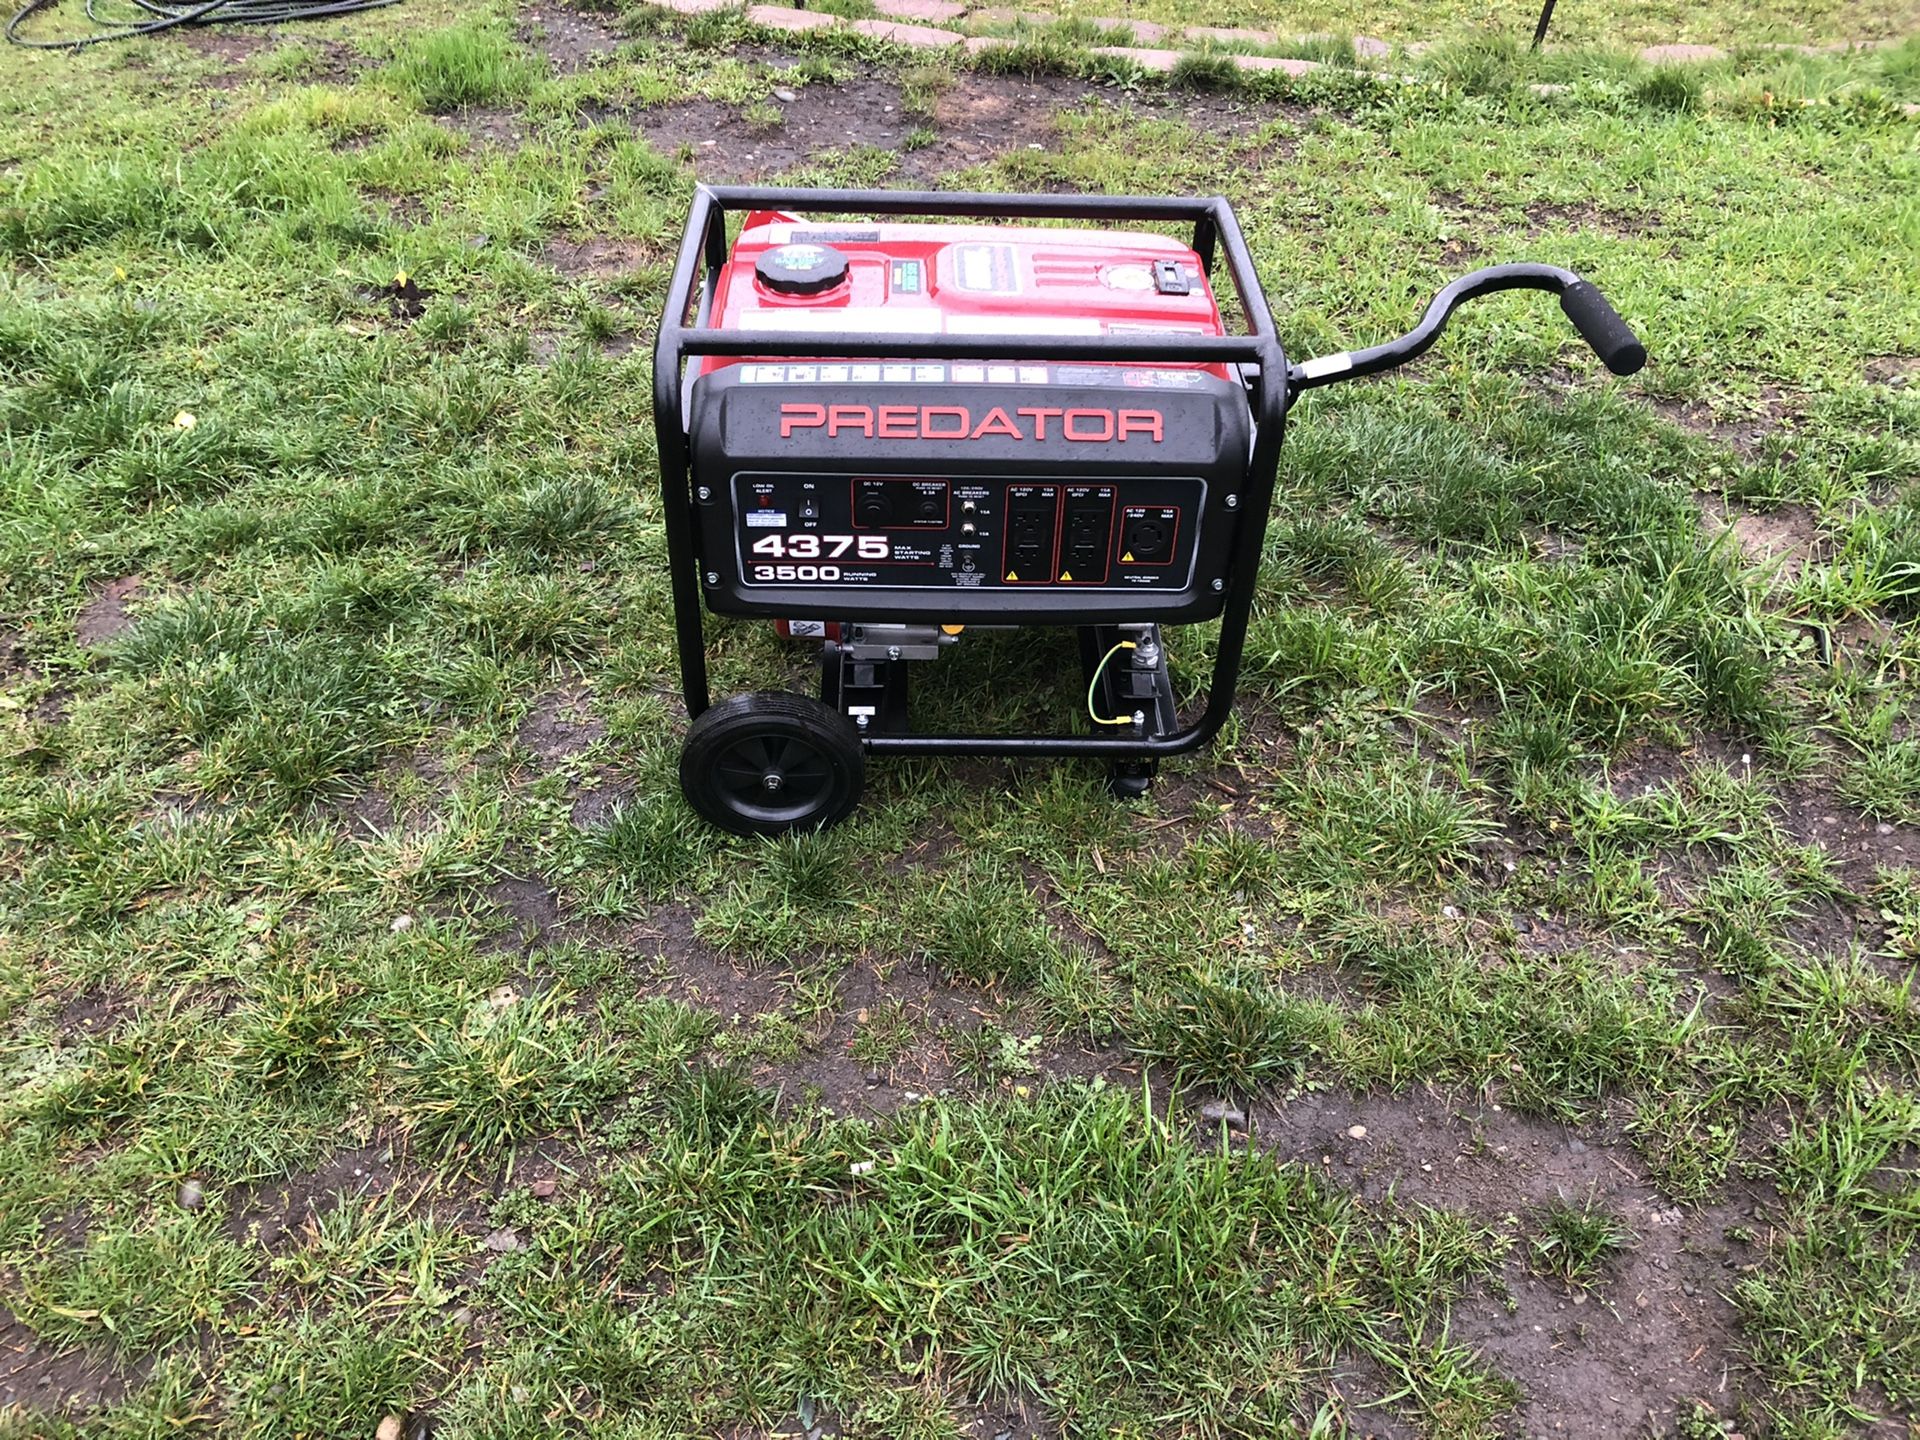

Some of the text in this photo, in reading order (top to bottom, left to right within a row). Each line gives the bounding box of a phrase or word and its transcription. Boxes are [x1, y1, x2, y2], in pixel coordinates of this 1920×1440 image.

[780, 402, 1164, 443] PREDATOR
[752, 534, 890, 559] 4375
[754, 565, 840, 581] 3500
